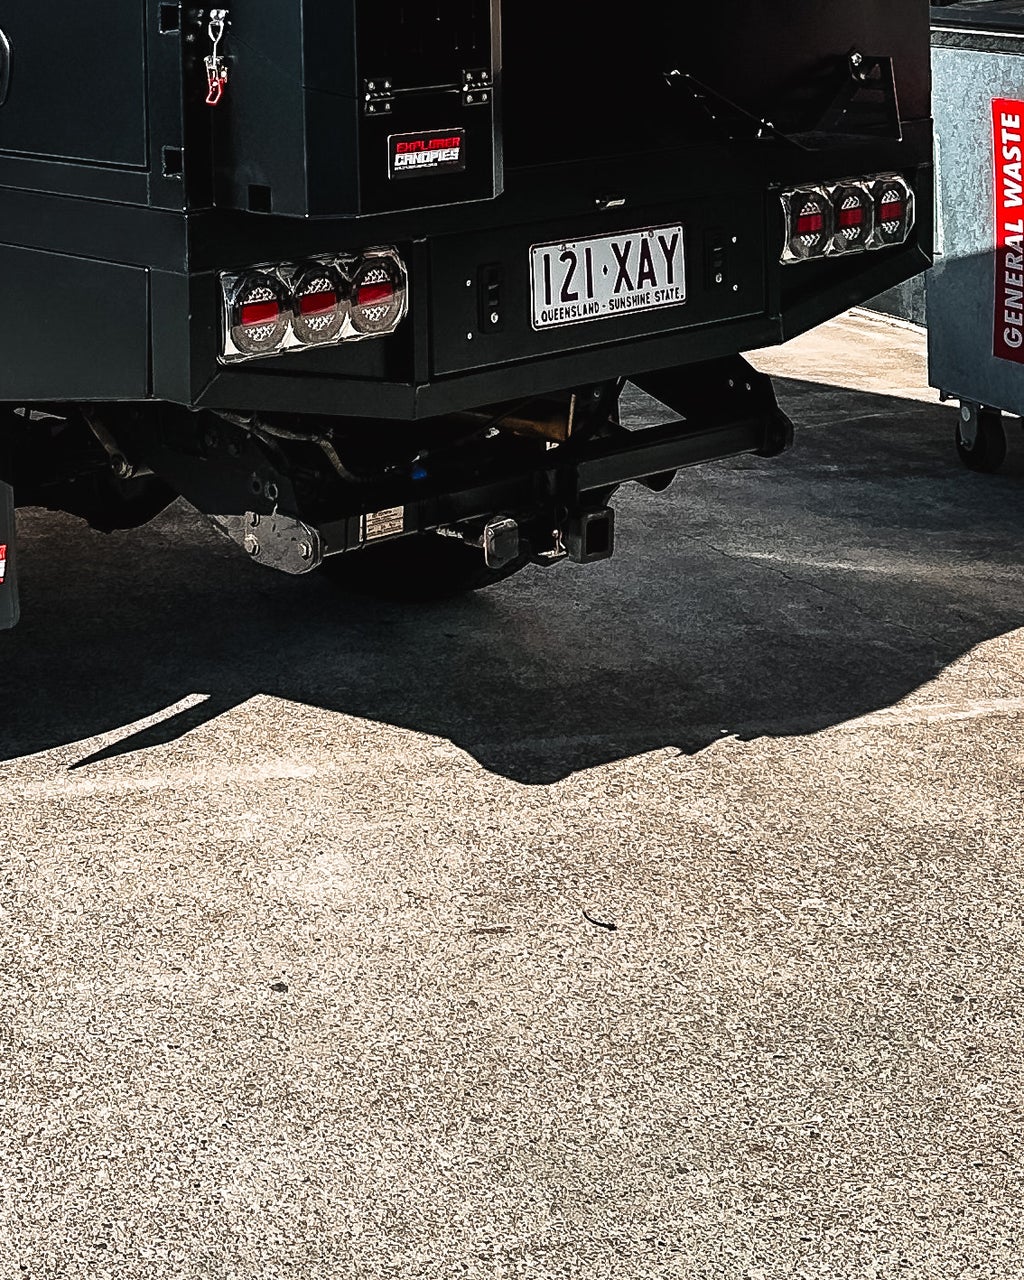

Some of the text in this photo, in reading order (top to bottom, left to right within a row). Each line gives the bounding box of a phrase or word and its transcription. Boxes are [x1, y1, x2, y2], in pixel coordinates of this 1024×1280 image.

[394, 147, 460, 167] CANOPIES
[396, 137, 461, 153] EXPLORER
[1000, 112, 1024, 349] GENERAL WASTE
[541, 301, 600, 323] QUEENSLAND
[608, 292, 651, 311] SUNSHINE
[655, 287, 680, 303] STATE
